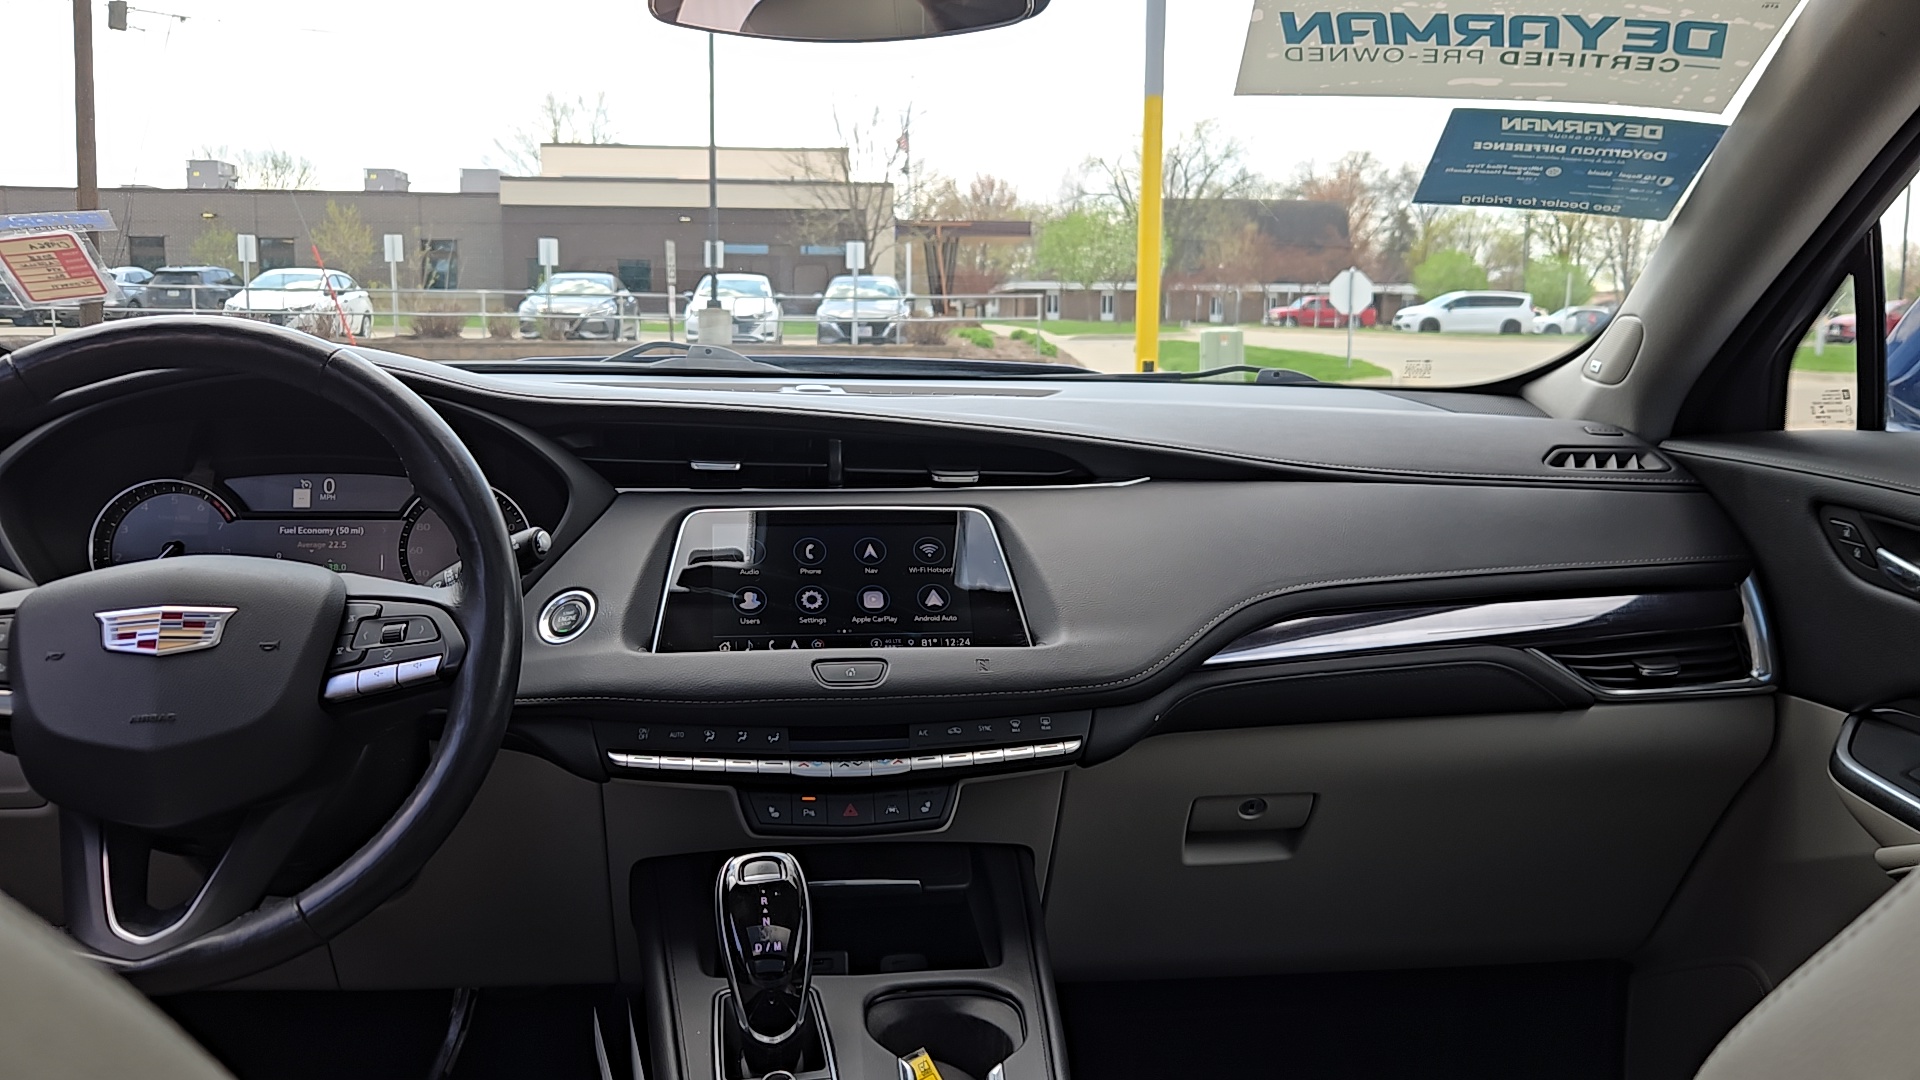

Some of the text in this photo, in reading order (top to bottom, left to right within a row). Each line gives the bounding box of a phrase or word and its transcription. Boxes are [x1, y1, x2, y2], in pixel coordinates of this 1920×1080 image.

[323, 478, 336, 494] 0
[319, 493, 337, 501] MPH
[279, 526, 365, 537] Fuel Economy (50 mi)
[297, 541, 347, 550] Average 22.5
[799, 567, 822, 575] Phone
[927, 566, 954, 574] Hotspot
[740, 617, 761, 625] Users
[799, 617, 826, 625] Settings
[851, 615, 898, 625] Apple CarPlay
[913, 614, 958, 622] Android Auto
[944, 637, 971, 647] 12:24
[978, 724, 992, 732] SYNC
[918, 729, 929, 737] A/C
[760, 896, 769, 906] R
[762, 916, 771, 927] N
